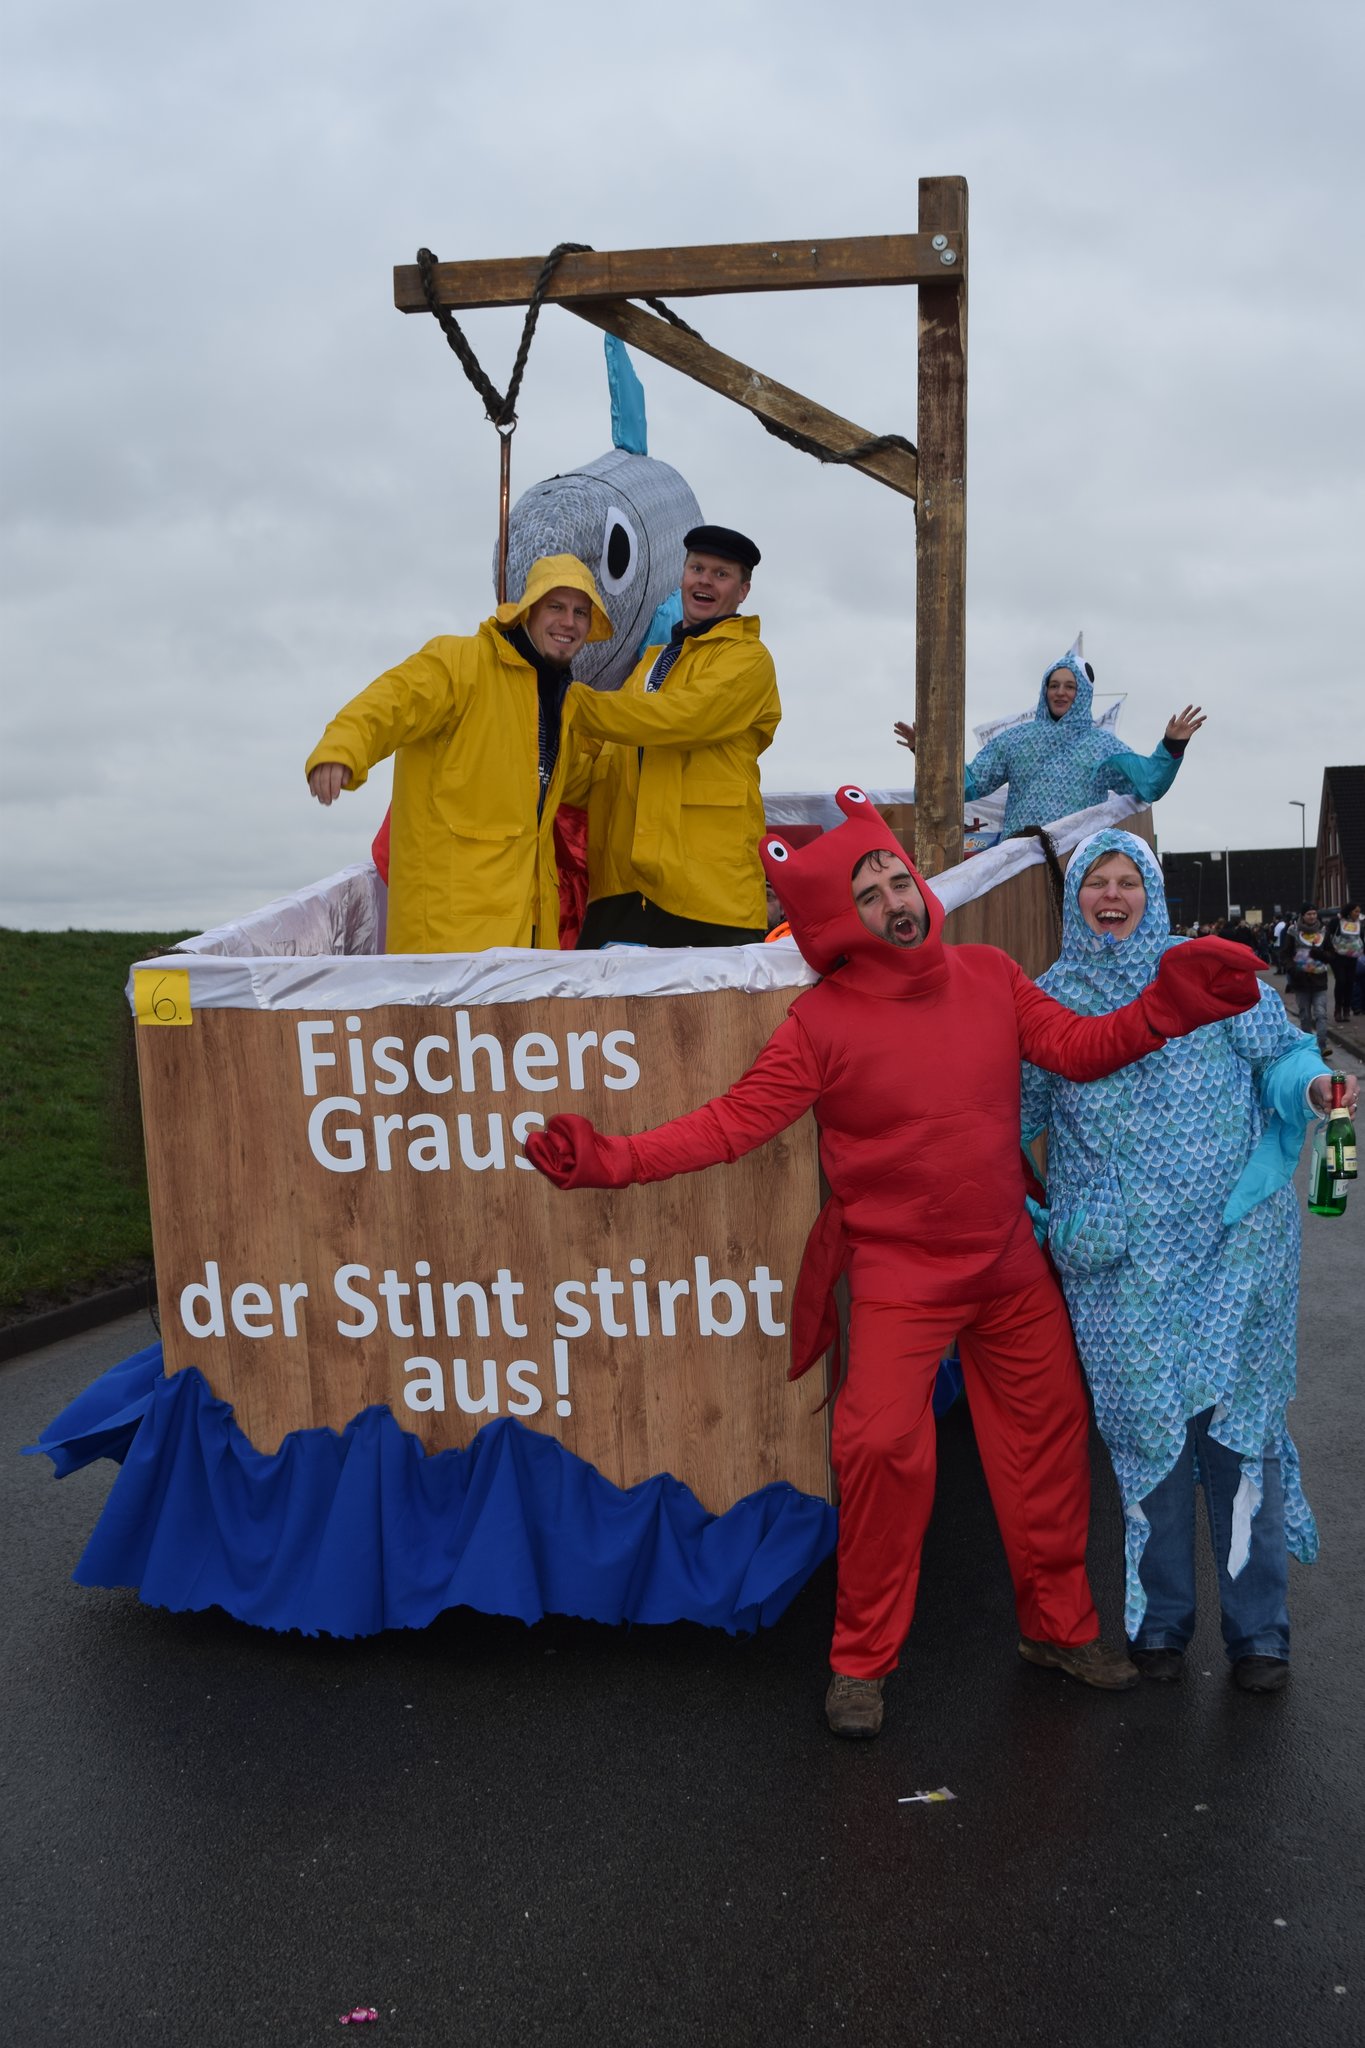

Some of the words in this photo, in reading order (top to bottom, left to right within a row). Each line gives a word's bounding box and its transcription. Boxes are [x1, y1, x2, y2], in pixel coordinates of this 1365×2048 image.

[297, 1010, 640, 1097] Fischers
[307, 1096, 545, 1173] Graus
[179, 1260, 309, 1339] der
[334, 1260, 528, 1339] Stint
[553, 1255, 786, 1338] stirbt
[403, 1338, 572, 1417] aus!
